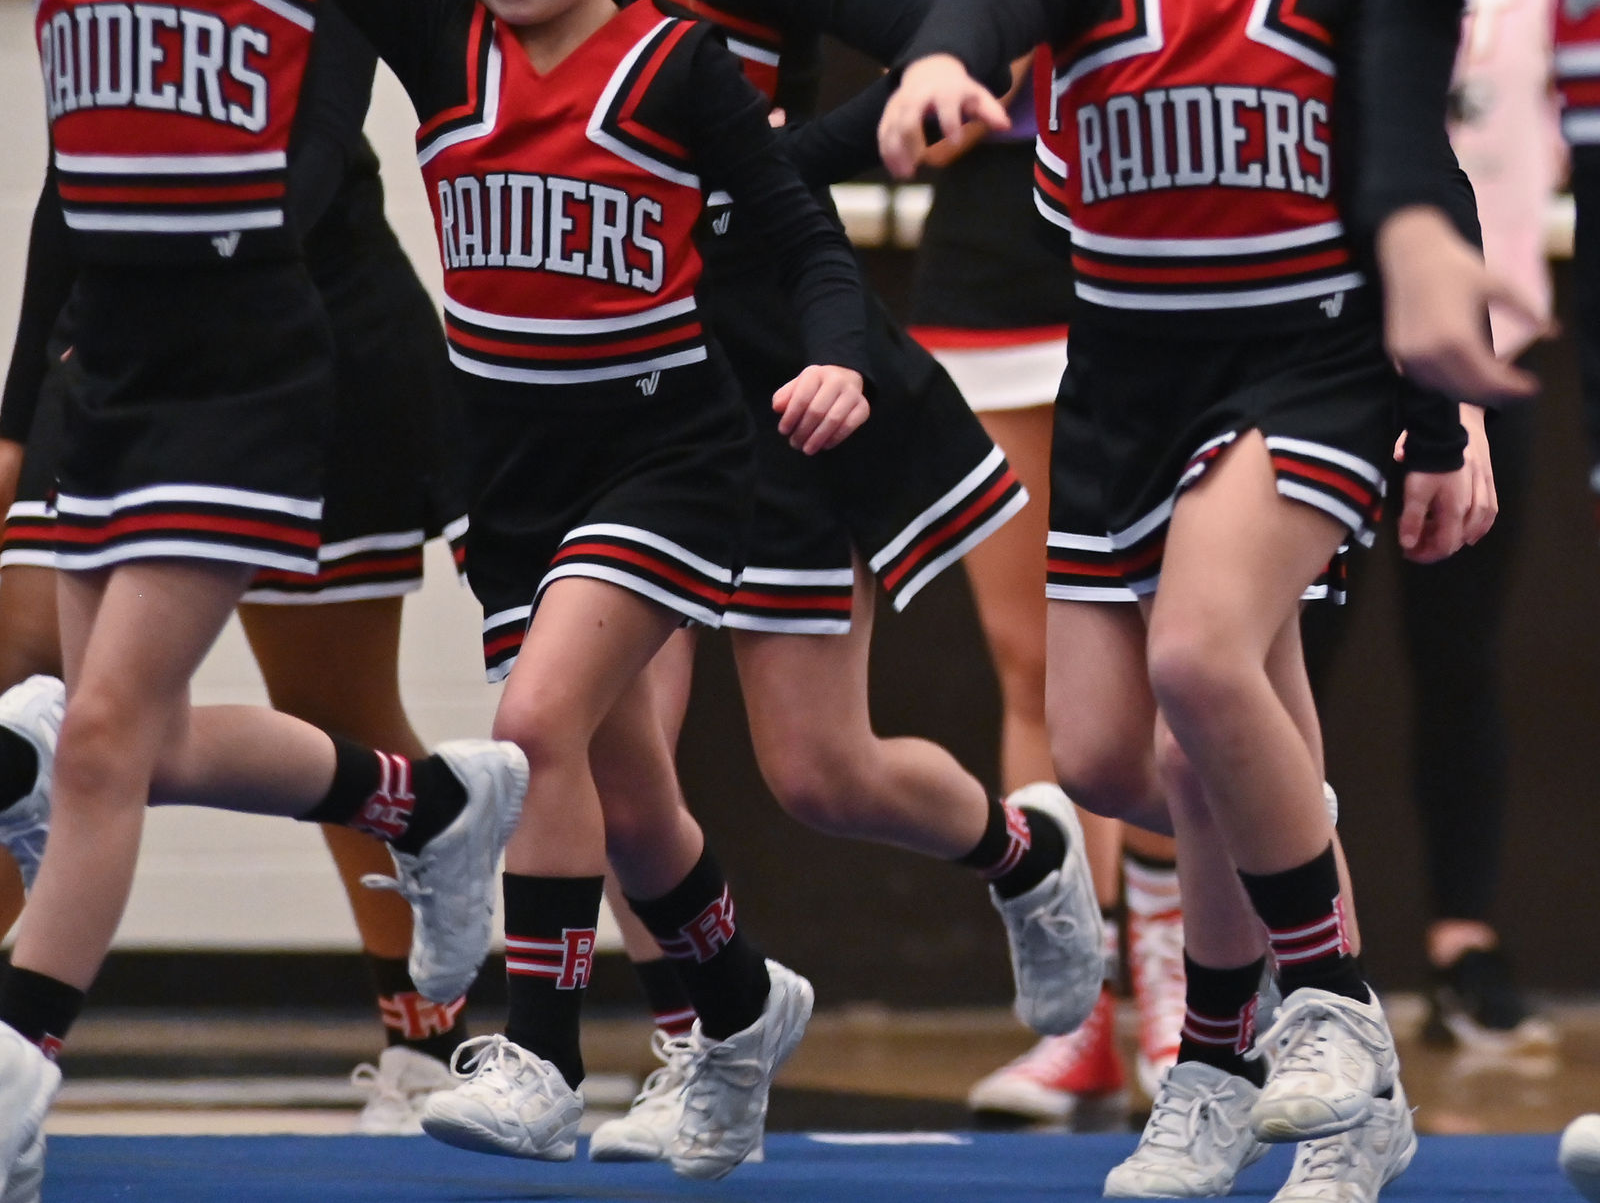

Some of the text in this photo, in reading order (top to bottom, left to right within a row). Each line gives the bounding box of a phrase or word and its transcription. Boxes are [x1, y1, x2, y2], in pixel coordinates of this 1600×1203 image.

[1076, 85, 1331, 204] RAIDERS
[437, 173, 663, 294] RAIDERS
[556, 928, 596, 990] R
